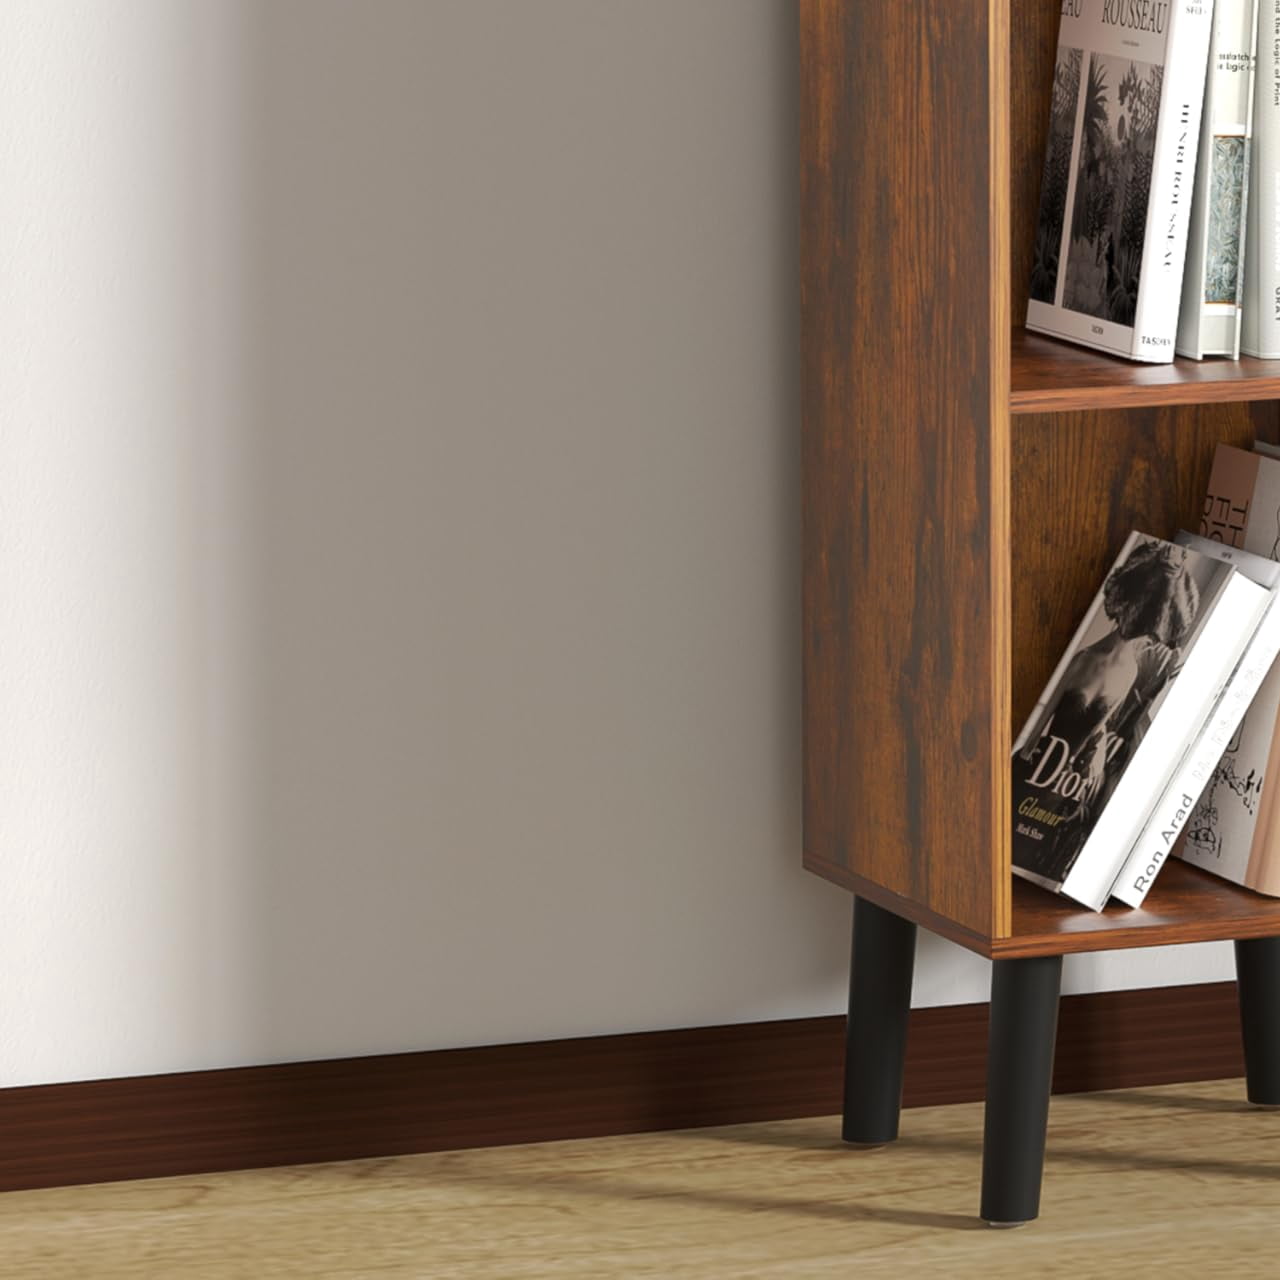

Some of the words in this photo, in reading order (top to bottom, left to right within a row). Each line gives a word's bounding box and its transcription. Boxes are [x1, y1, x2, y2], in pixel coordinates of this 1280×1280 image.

[1025, 735, 1088, 802] Dior
[1018, 796, 1067, 827] Glamour
[1133, 851, 1164, 893] Ron
[1161, 794, 1193, 844] Arad
